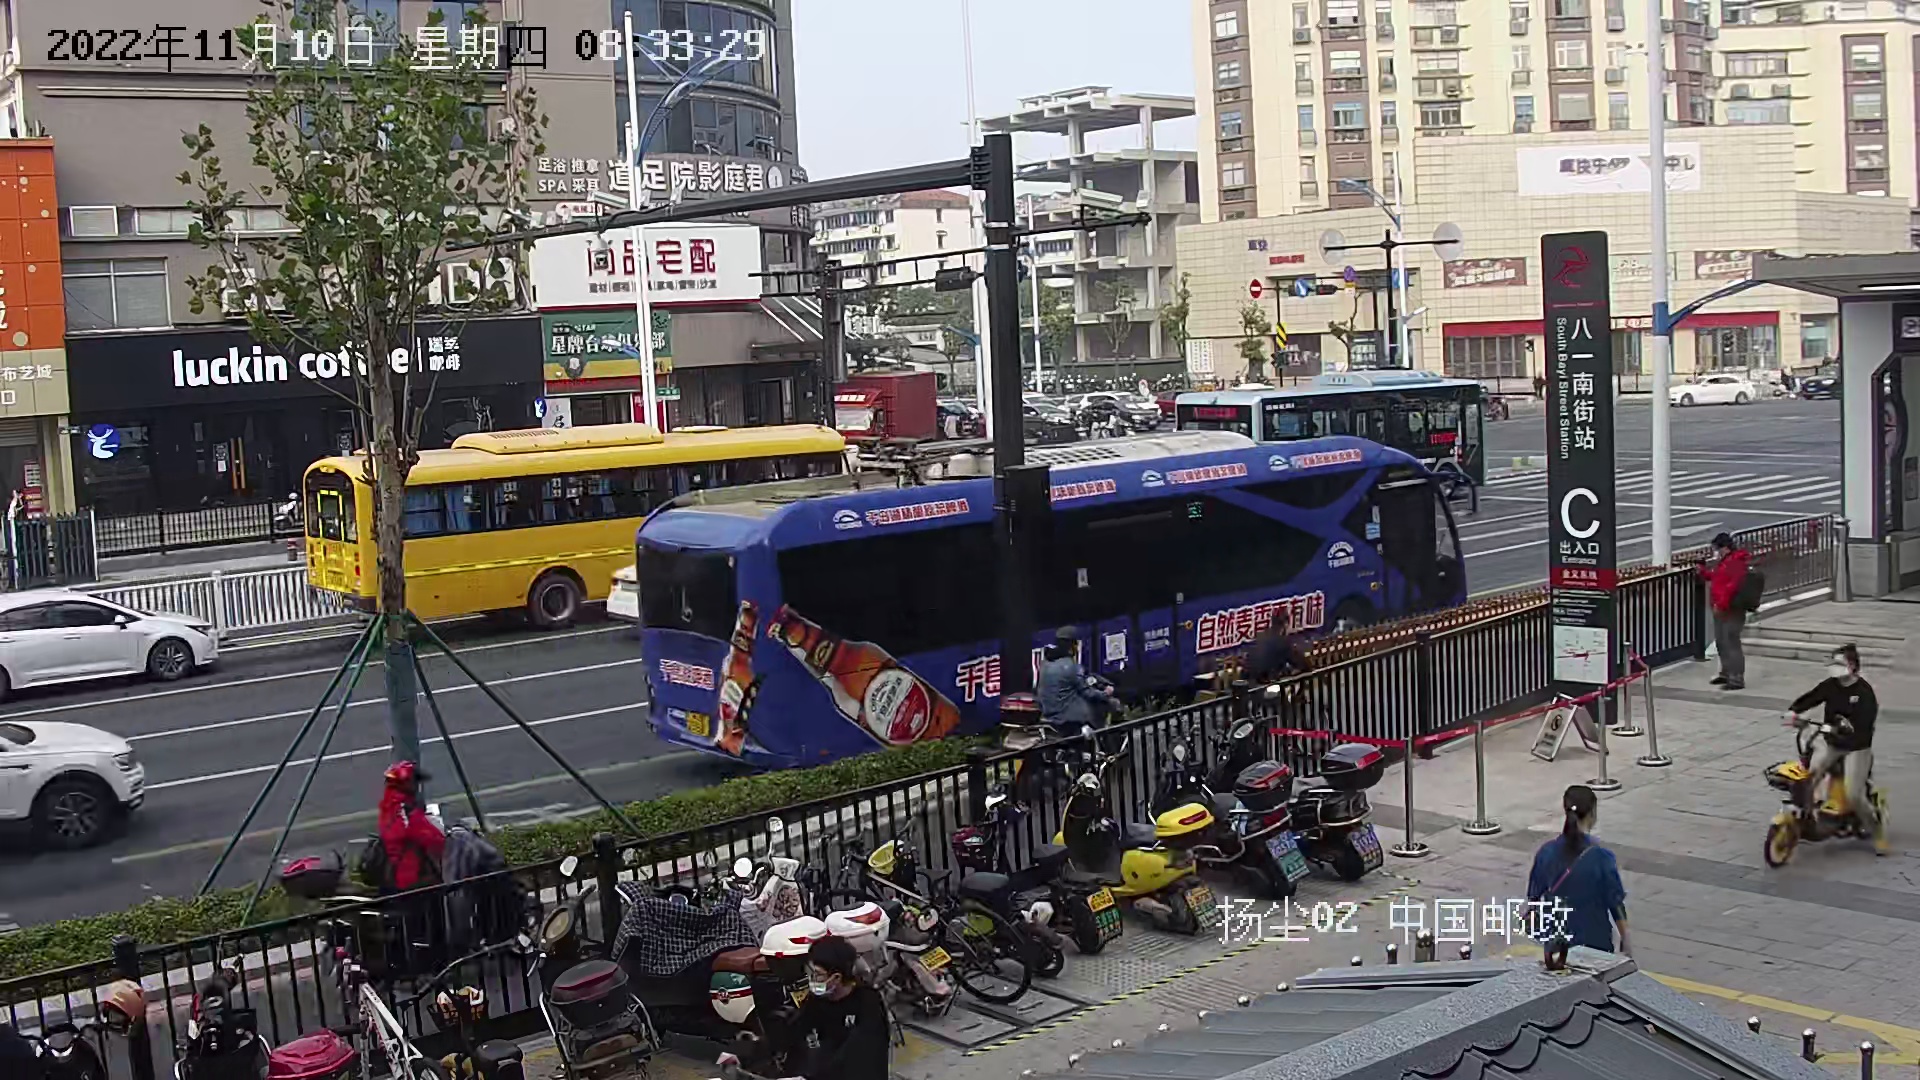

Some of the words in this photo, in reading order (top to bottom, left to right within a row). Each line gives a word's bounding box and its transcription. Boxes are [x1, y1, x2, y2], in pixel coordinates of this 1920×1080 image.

[538, 157, 566, 174] 足浴
[572, 157, 599, 174] 推拿
[538, 179, 567, 193] SPA
[572, 178, 599, 193] 采耳
[1556, 317, 1569, 351] South
[1, 364, 53, 382] 布艺城
[172, 345, 288, 387] luckin
[429, 353, 461, 371] 咖啡
[1556, 353, 1569, 379] Bayi
[1558, 381, 1570, 416] Street
[1571, 317, 1596, 451] 八一南街站
[1559, 418, 1570, 459] Station
[1561, 487, 1601, 540] C
[1560, 541, 1600, 555] 出入口
